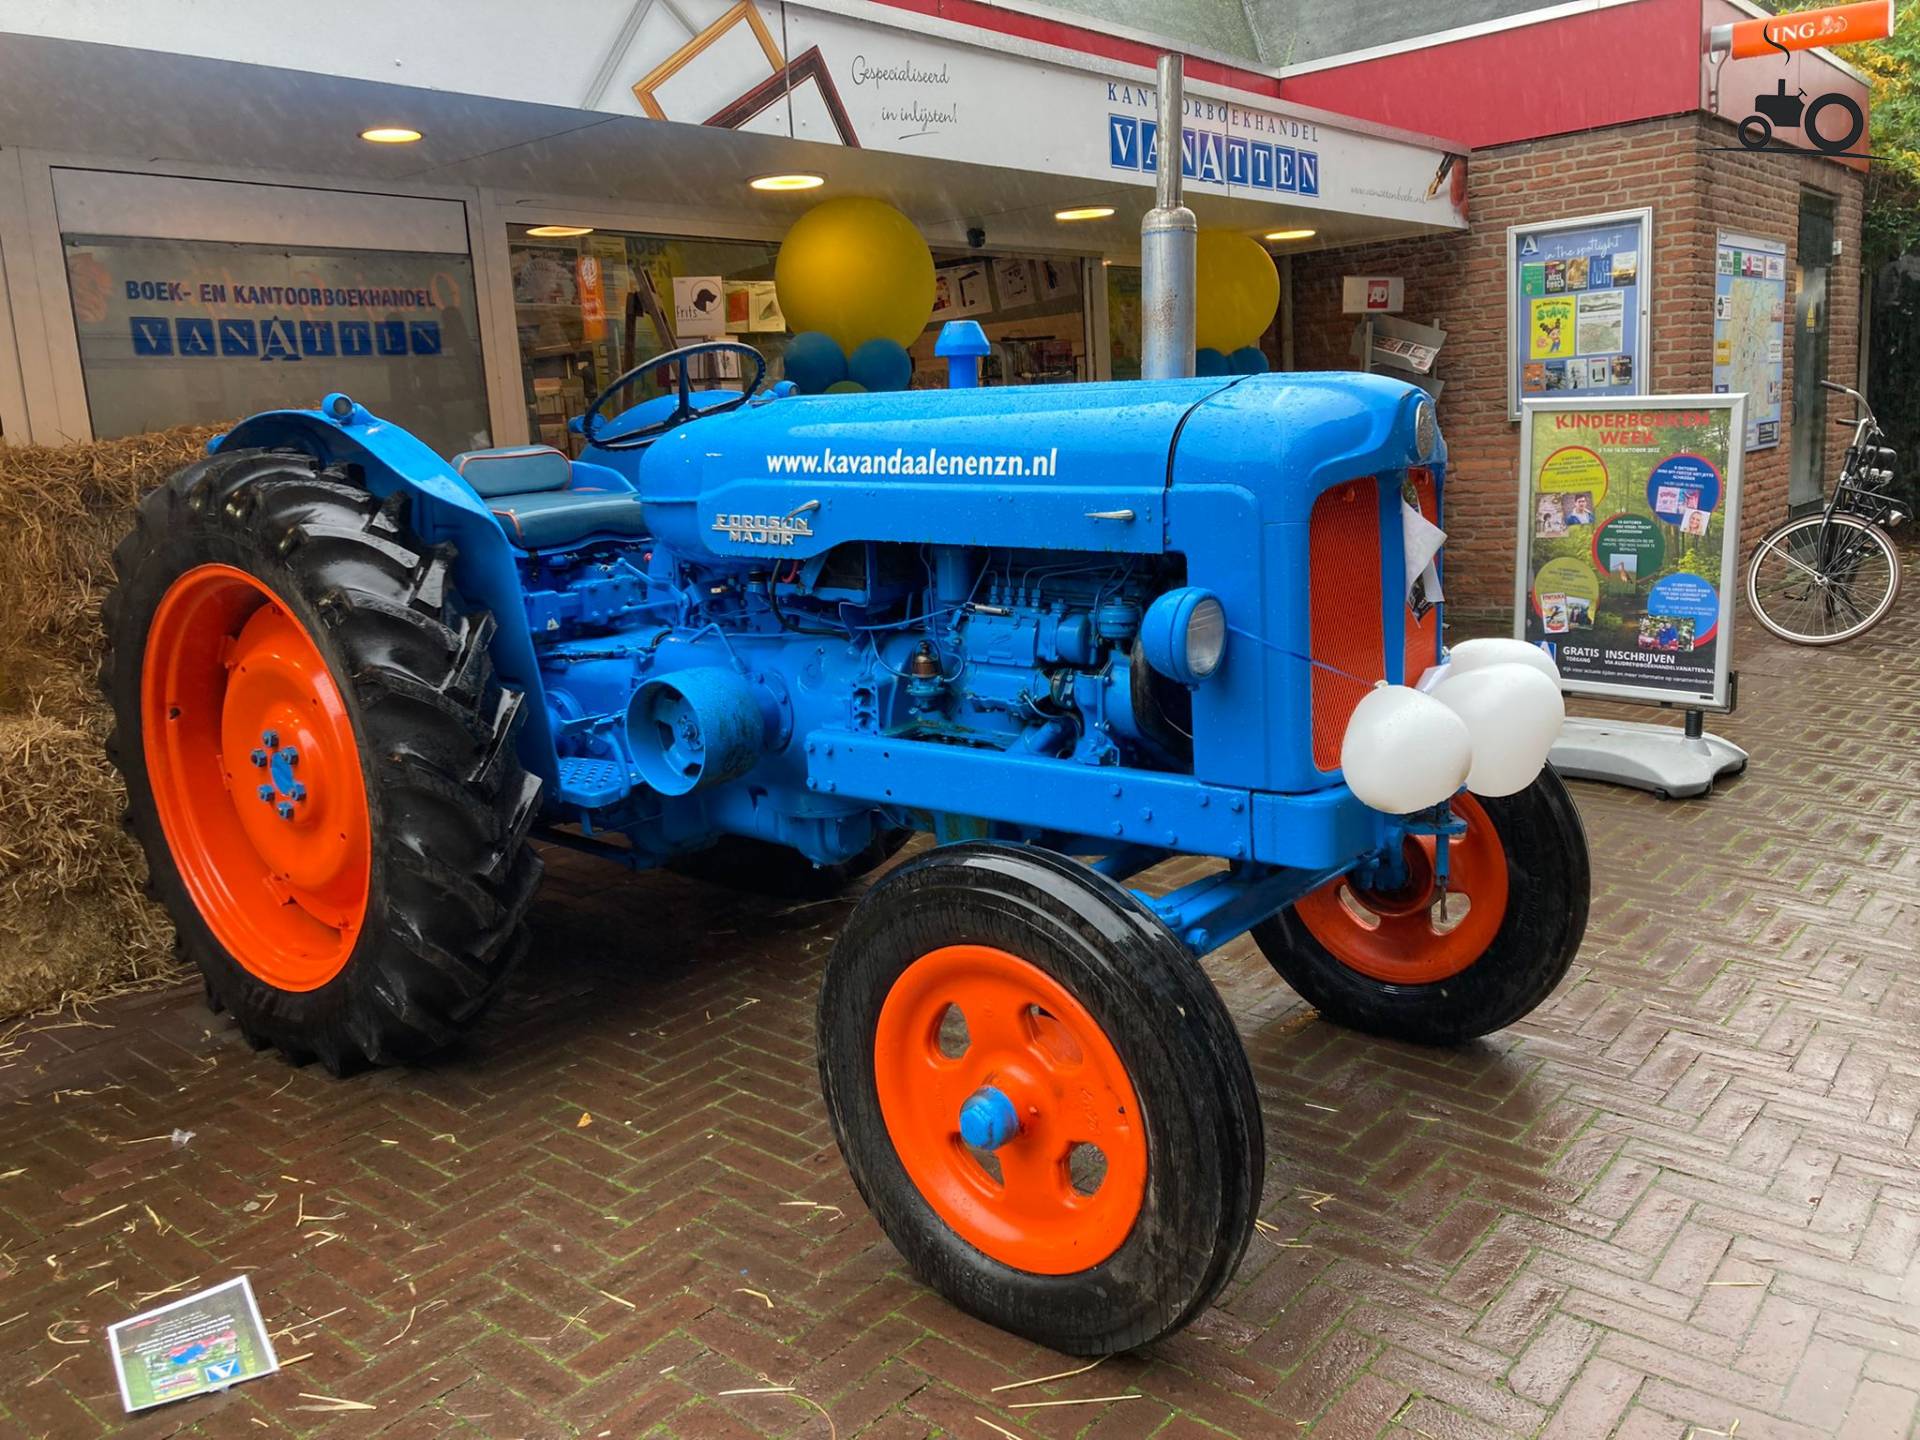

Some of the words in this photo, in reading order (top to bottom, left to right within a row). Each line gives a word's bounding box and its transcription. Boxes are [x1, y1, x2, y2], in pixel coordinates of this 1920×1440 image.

[1772, 23, 1815, 43] ING
[852, 55, 950, 90] Gespecialiseerd
[881, 106, 898, 121] in
[1107, 82, 1319, 143] KANTORBOEKHANDEL
[126, 280, 192, 301] BOEK-
[200, 284, 226, 303] EN
[233, 286, 436, 307] KANTOORBOEKHANDEL
[1555, 411, 1711, 430] KINDERBOEKEN
[1600, 430, 1659, 446] WEEK
[766, 447, 1058, 477] www.kavandaalenenzn.nl
[729, 530, 794, 545] MAJOR
[1563, 646, 1600, 658] GRATIS
[1605, 649, 1675, 665] INSCHRIJVEN
